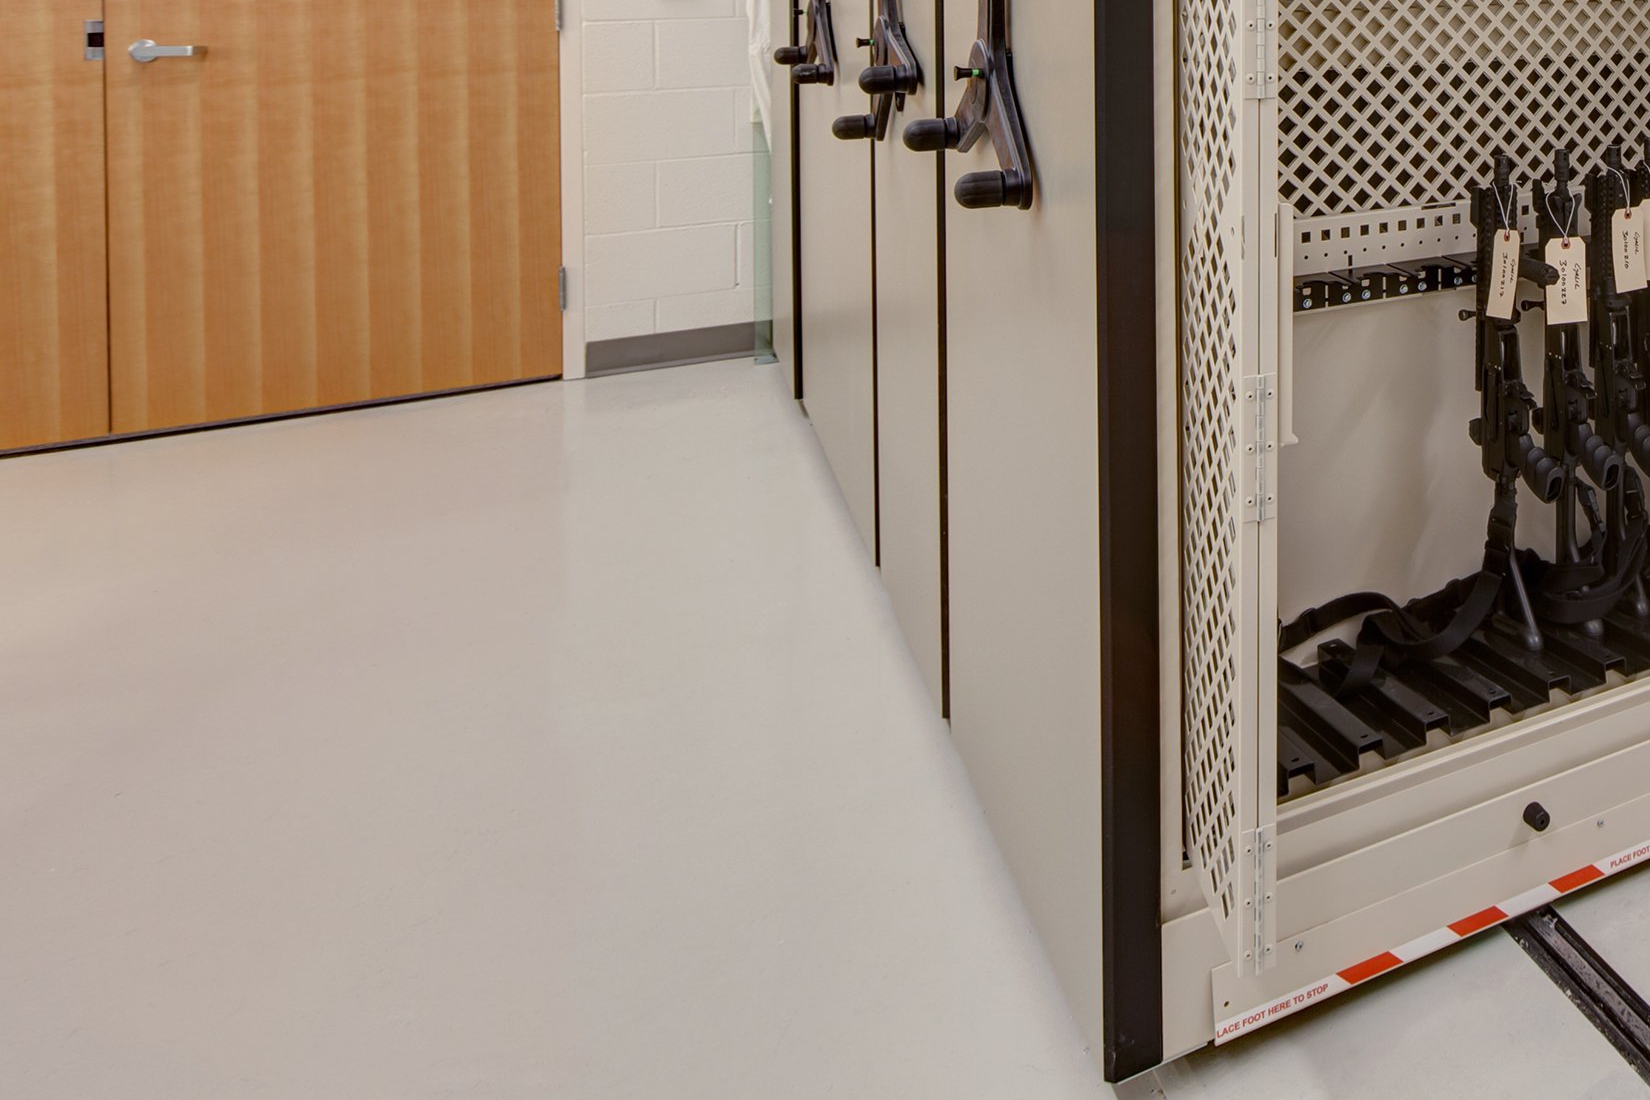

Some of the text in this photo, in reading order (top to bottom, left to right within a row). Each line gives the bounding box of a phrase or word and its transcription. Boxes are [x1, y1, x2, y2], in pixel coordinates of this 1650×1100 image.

[1610, 853, 1632, 868] PLACE
[1633, 845, 1650, 859] FOOT
[1216, 983, 1329, 1038] LACE FOOT HERE TO STOP
